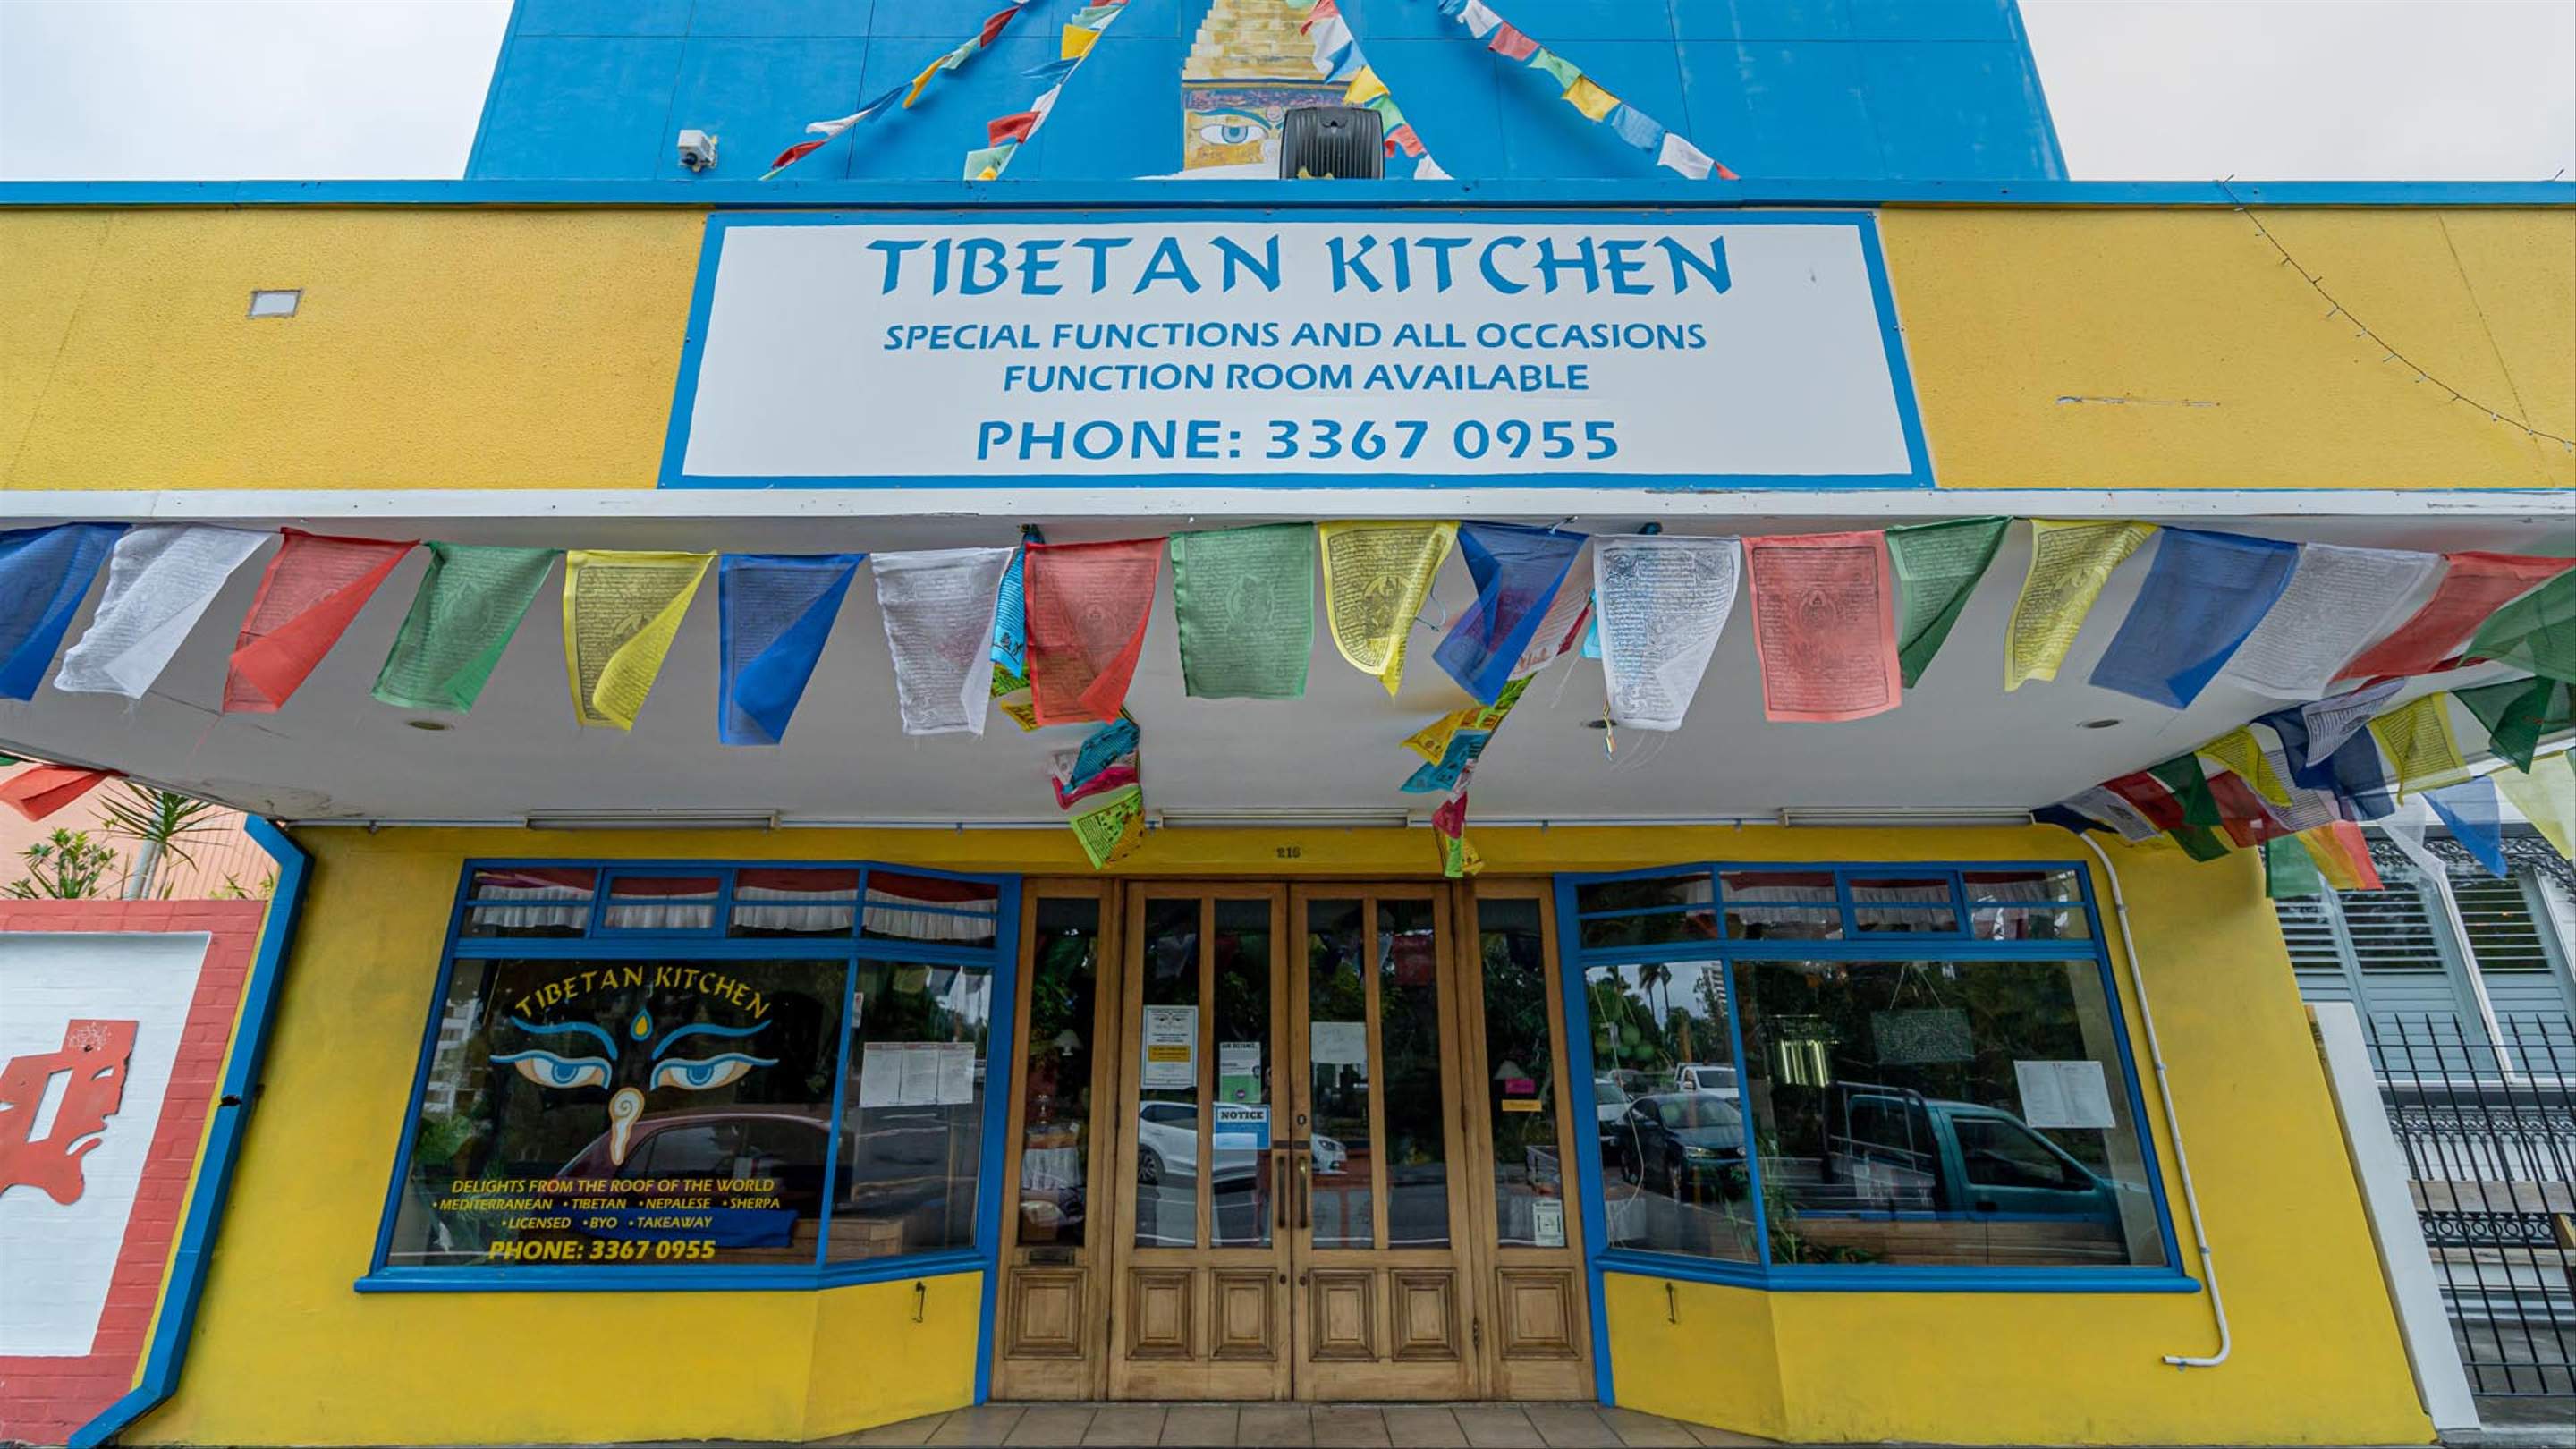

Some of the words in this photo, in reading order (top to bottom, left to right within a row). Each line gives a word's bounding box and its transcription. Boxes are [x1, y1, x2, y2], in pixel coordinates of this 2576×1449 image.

[868, 236, 1280, 295] TIBETAN
[1326, 235, 1732, 295] KITCHEN
[885, 325, 1039, 350] SPECIAL
[1053, 322, 1278, 350] FUNCTIONS
[1292, 323, 1382, 347] AND
[1394, 324, 1467, 347] ALL
[1477, 323, 1707, 349] OCCASIONS
[1004, 364, 1214, 392] FUNCTION
[1227, 364, 1352, 391] ROOM
[1364, 364, 1589, 392] AVAILABLE
[978, 420, 1241, 460] PHONE:
[1267, 420, 1428, 460] 3367
[1454, 420, 1618, 460] 0955
[514, 965, 643, 1018] TIBETAN
[655, 966, 771, 1019] KITCHEN
[1220, 1111, 1265, 1120] NOTICE
[452, 1180, 525, 1193] DELIGHTS
[529, 1180, 573, 1192] FROM
[578, 1180, 607, 1192] THE
[610, 1180, 655, 1192] ROOF
[657, 1180, 678, 1192] OF
[684, 1179, 713, 1192] THE
[716, 1179, 775, 1192] WORLD
[439, 1199, 553, 1210] MEDITERRANEAN
[572, 1199, 627, 1209] TIBETAN
[646, 1198, 711, 1209] NEPALESE
[729, 1198, 780, 1209] SHERPA
[507, 1217, 571, 1229] LICENSED
[589, 1217, 618, 1229] BYO
[637, 1216, 713, 1228] TAKEAWAY
[488, 1240, 584, 1260] PHONE:
[589, 1240, 651, 1260] 3367
[655, 1240, 716, 1260] 0955
